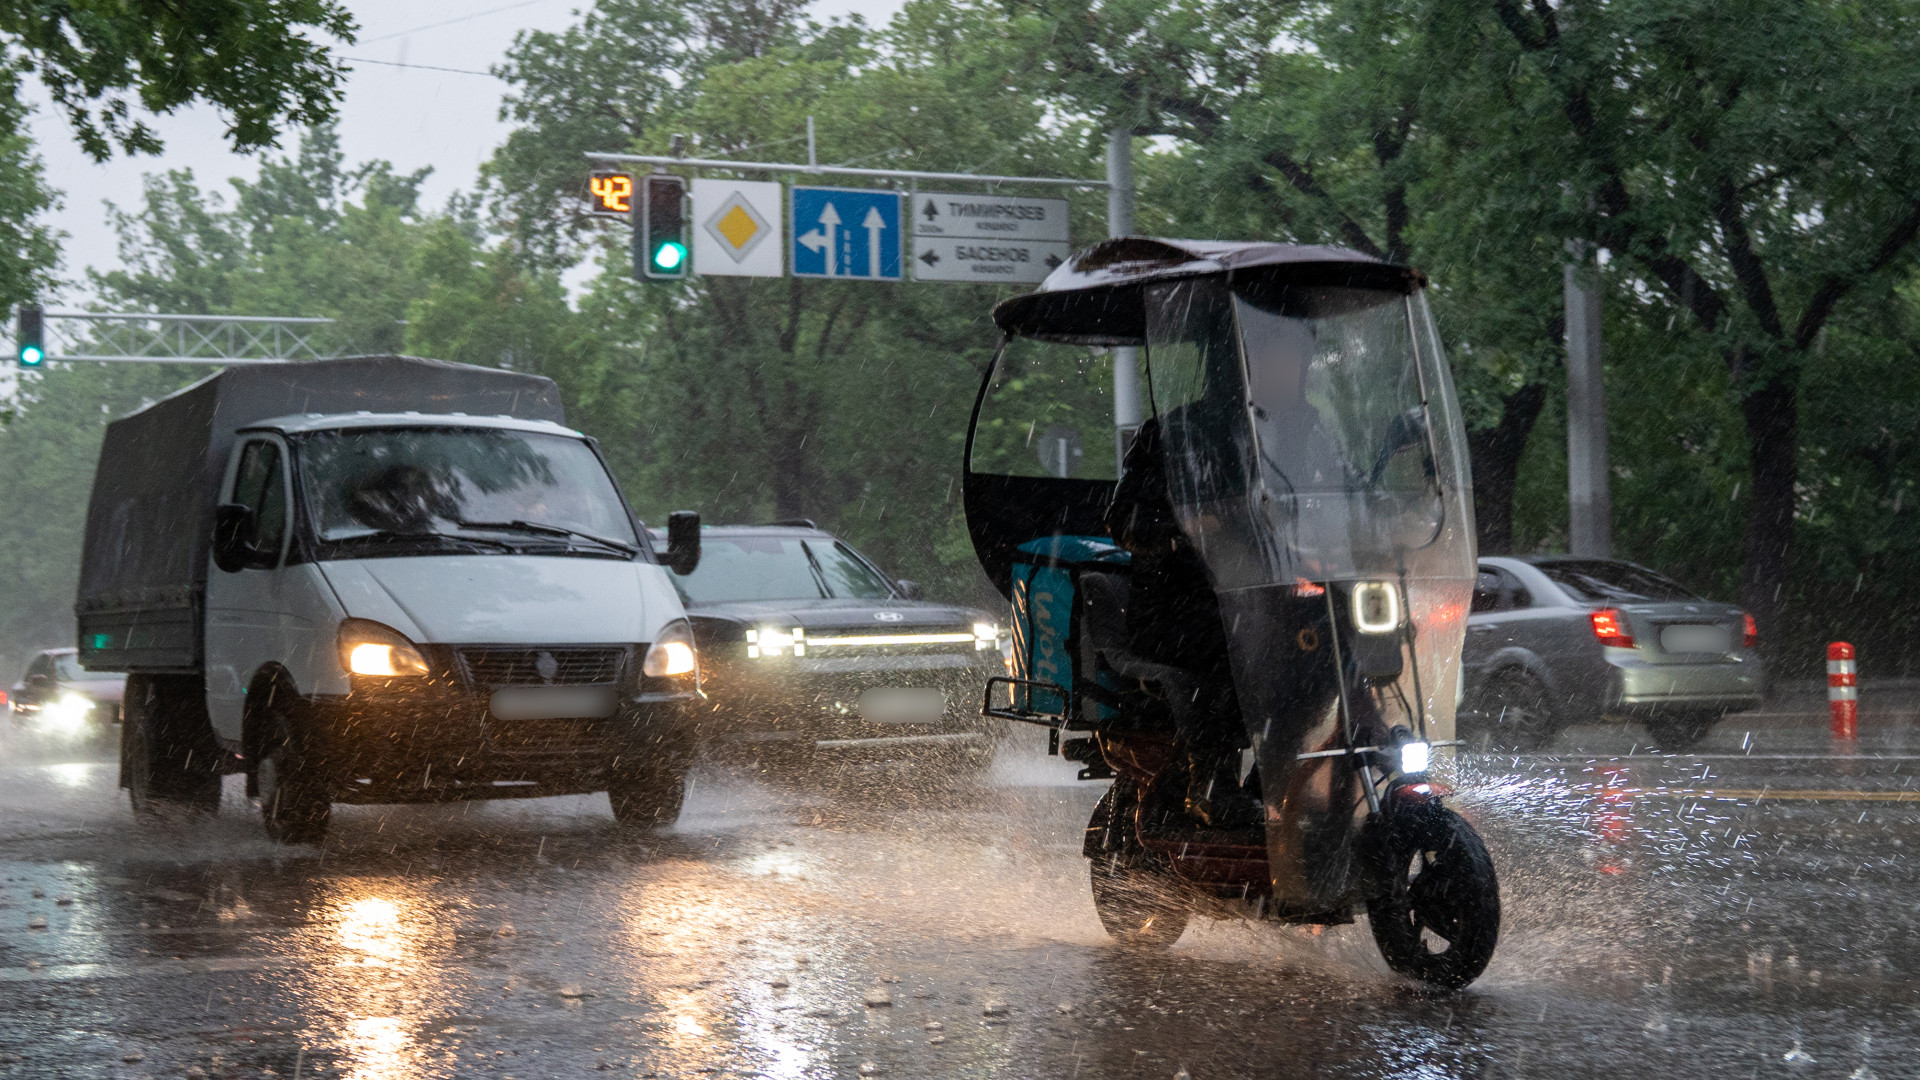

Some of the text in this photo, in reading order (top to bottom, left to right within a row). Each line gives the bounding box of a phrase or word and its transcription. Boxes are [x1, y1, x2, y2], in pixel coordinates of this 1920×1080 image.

[591, 176, 632, 211] 42
[948, 202, 1046, 221] ТИМИРЯЗЕВ
[955, 244, 1031, 262] БАСЕНОВ
